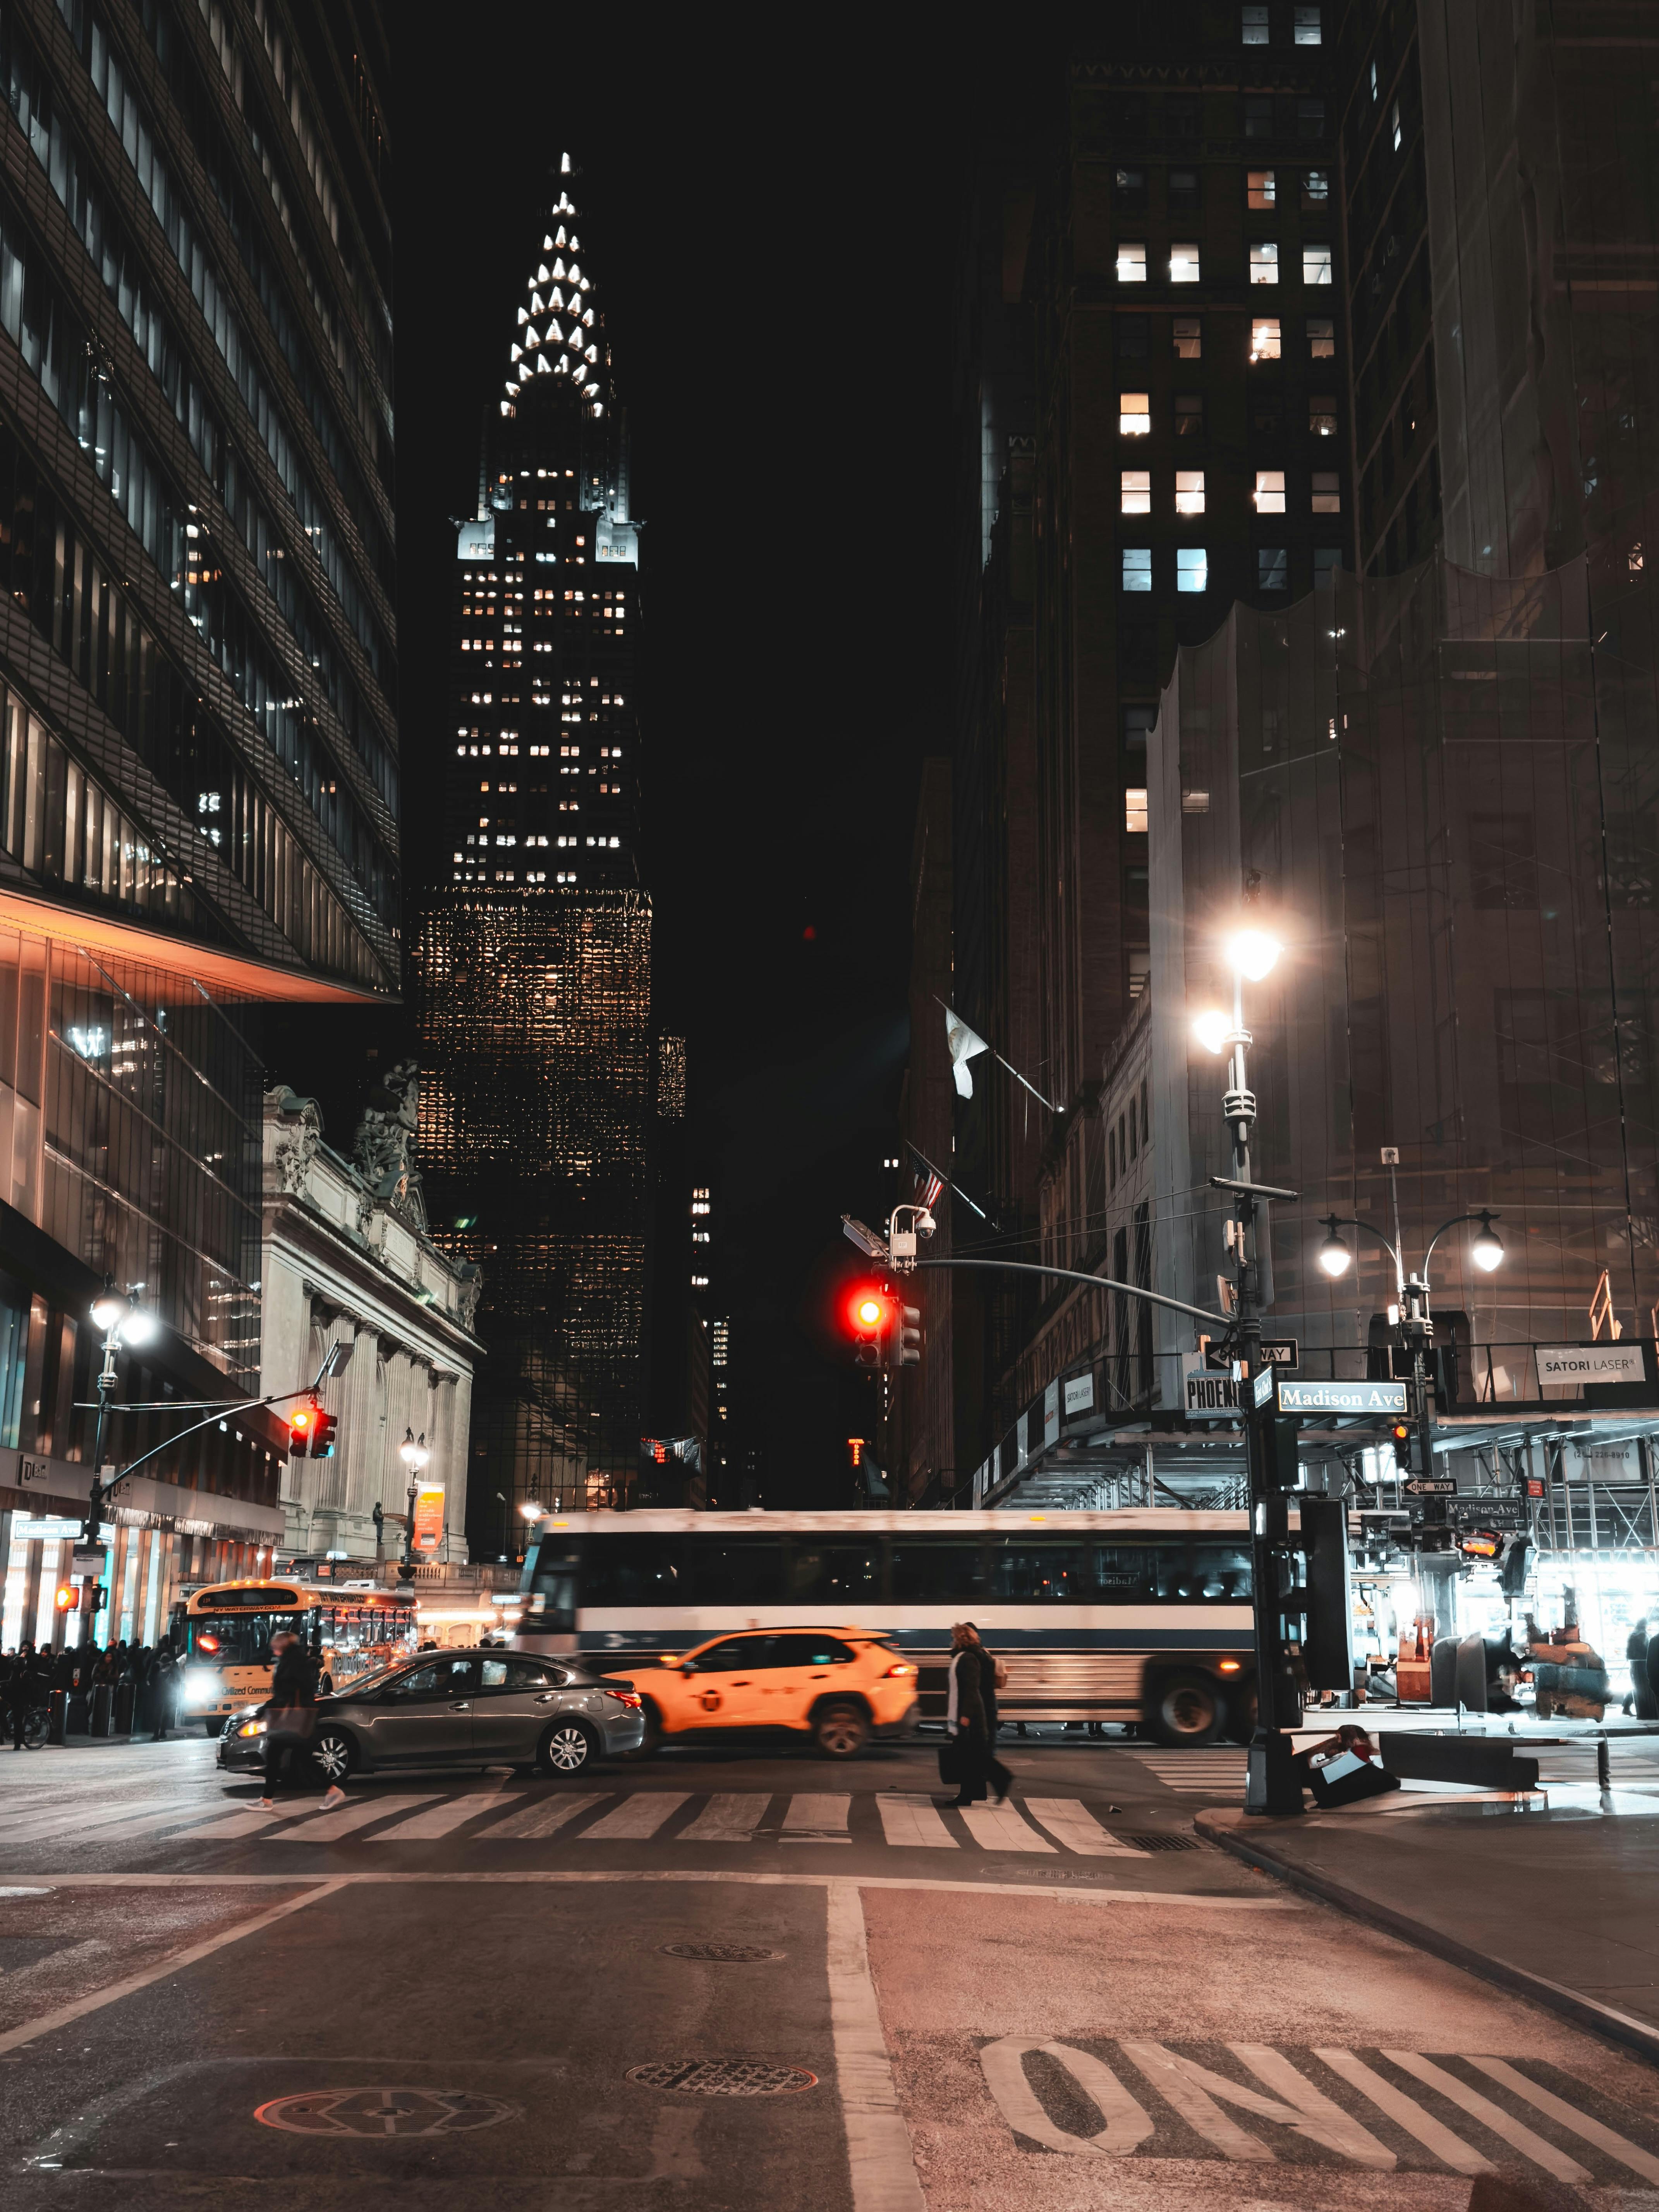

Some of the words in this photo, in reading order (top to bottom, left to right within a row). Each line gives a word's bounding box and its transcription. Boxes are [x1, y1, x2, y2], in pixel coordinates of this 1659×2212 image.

[1546, 1361, 1589, 1372] SATORI
[1067, 1390, 1079, 1403] SATORI
[1187, 1380, 1238, 1409] PHOENI
[1282, 1389, 1363, 1406] Madison
[1368, 1390, 1404, 1407] Ave
[1449, 1504, 1494, 1514] Madison
[1498, 1504, 1518, 1514] Ave
[19, 1526, 58, 1534] Madison
[61, 1525, 79, 1534] Ave
[222, 1686, 246, 1695] Civilized
